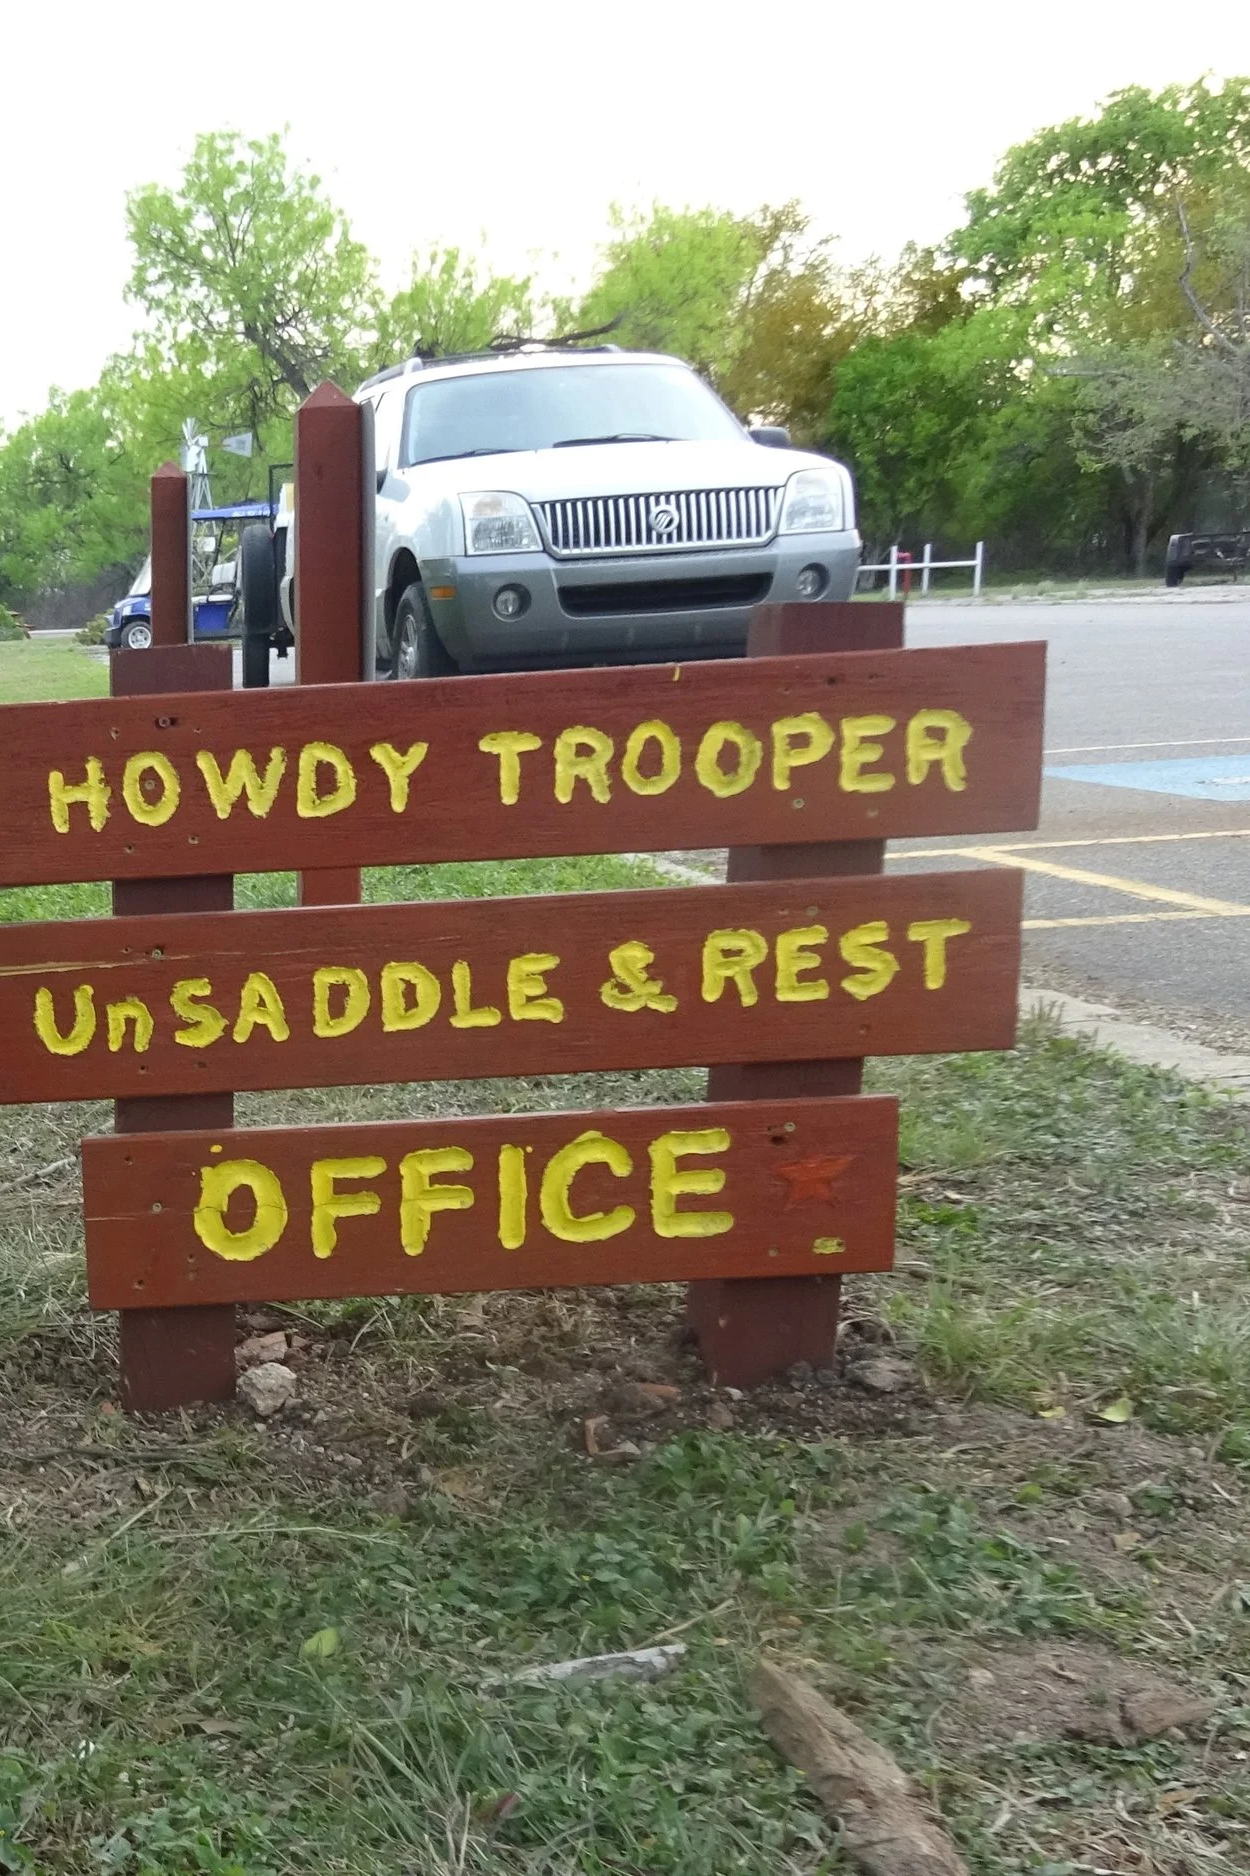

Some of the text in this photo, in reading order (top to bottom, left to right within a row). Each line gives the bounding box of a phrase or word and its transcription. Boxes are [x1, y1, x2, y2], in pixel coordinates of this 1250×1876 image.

[47, 707, 974, 834] HOWDY TROOPER
[600, 939, 680, 1014] &
[701, 917, 972, 1008] REST
[192, 1127, 735, 1262] OFFICE
